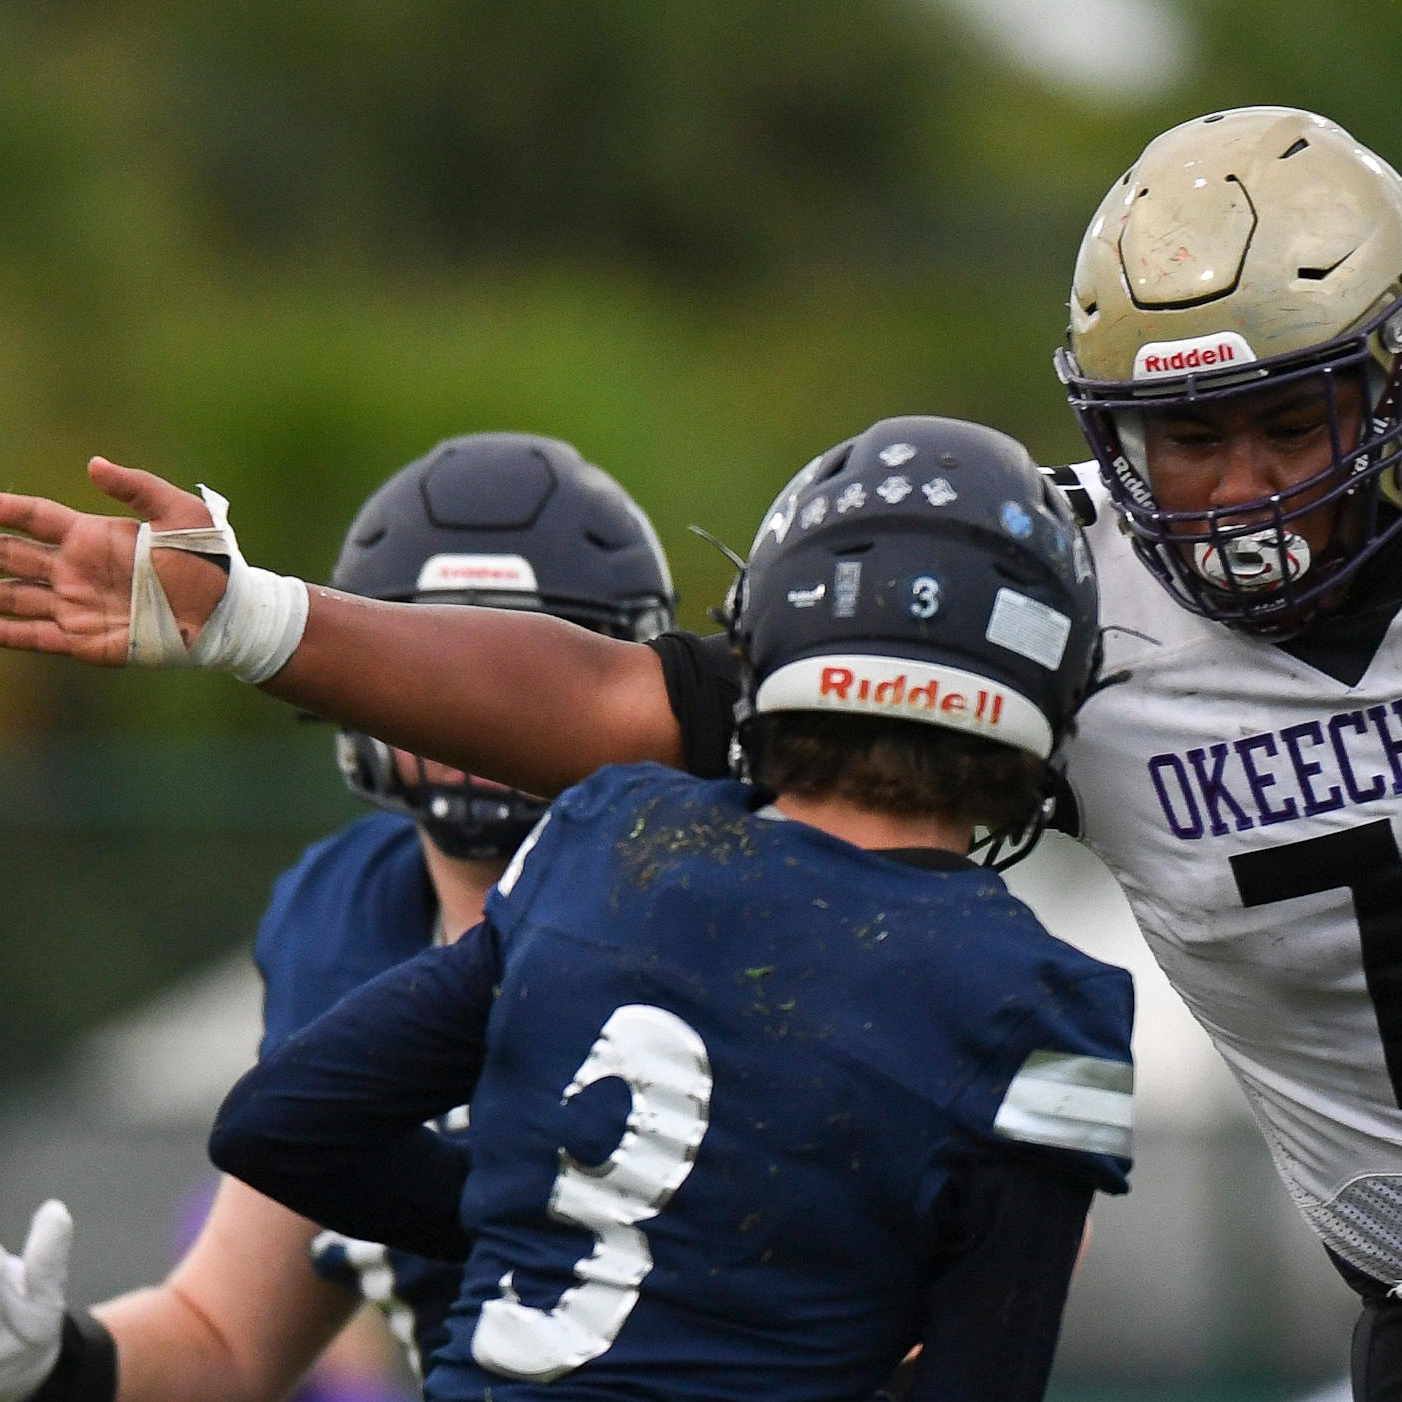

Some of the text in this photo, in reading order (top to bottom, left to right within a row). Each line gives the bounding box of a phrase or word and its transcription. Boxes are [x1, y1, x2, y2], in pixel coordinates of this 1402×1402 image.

[1145, 344, 1234, 372] Riddell
[910, 576, 939, 618] 3
[820, 667, 1004, 726] Riddell
[471, 1003, 713, 1383] 3
